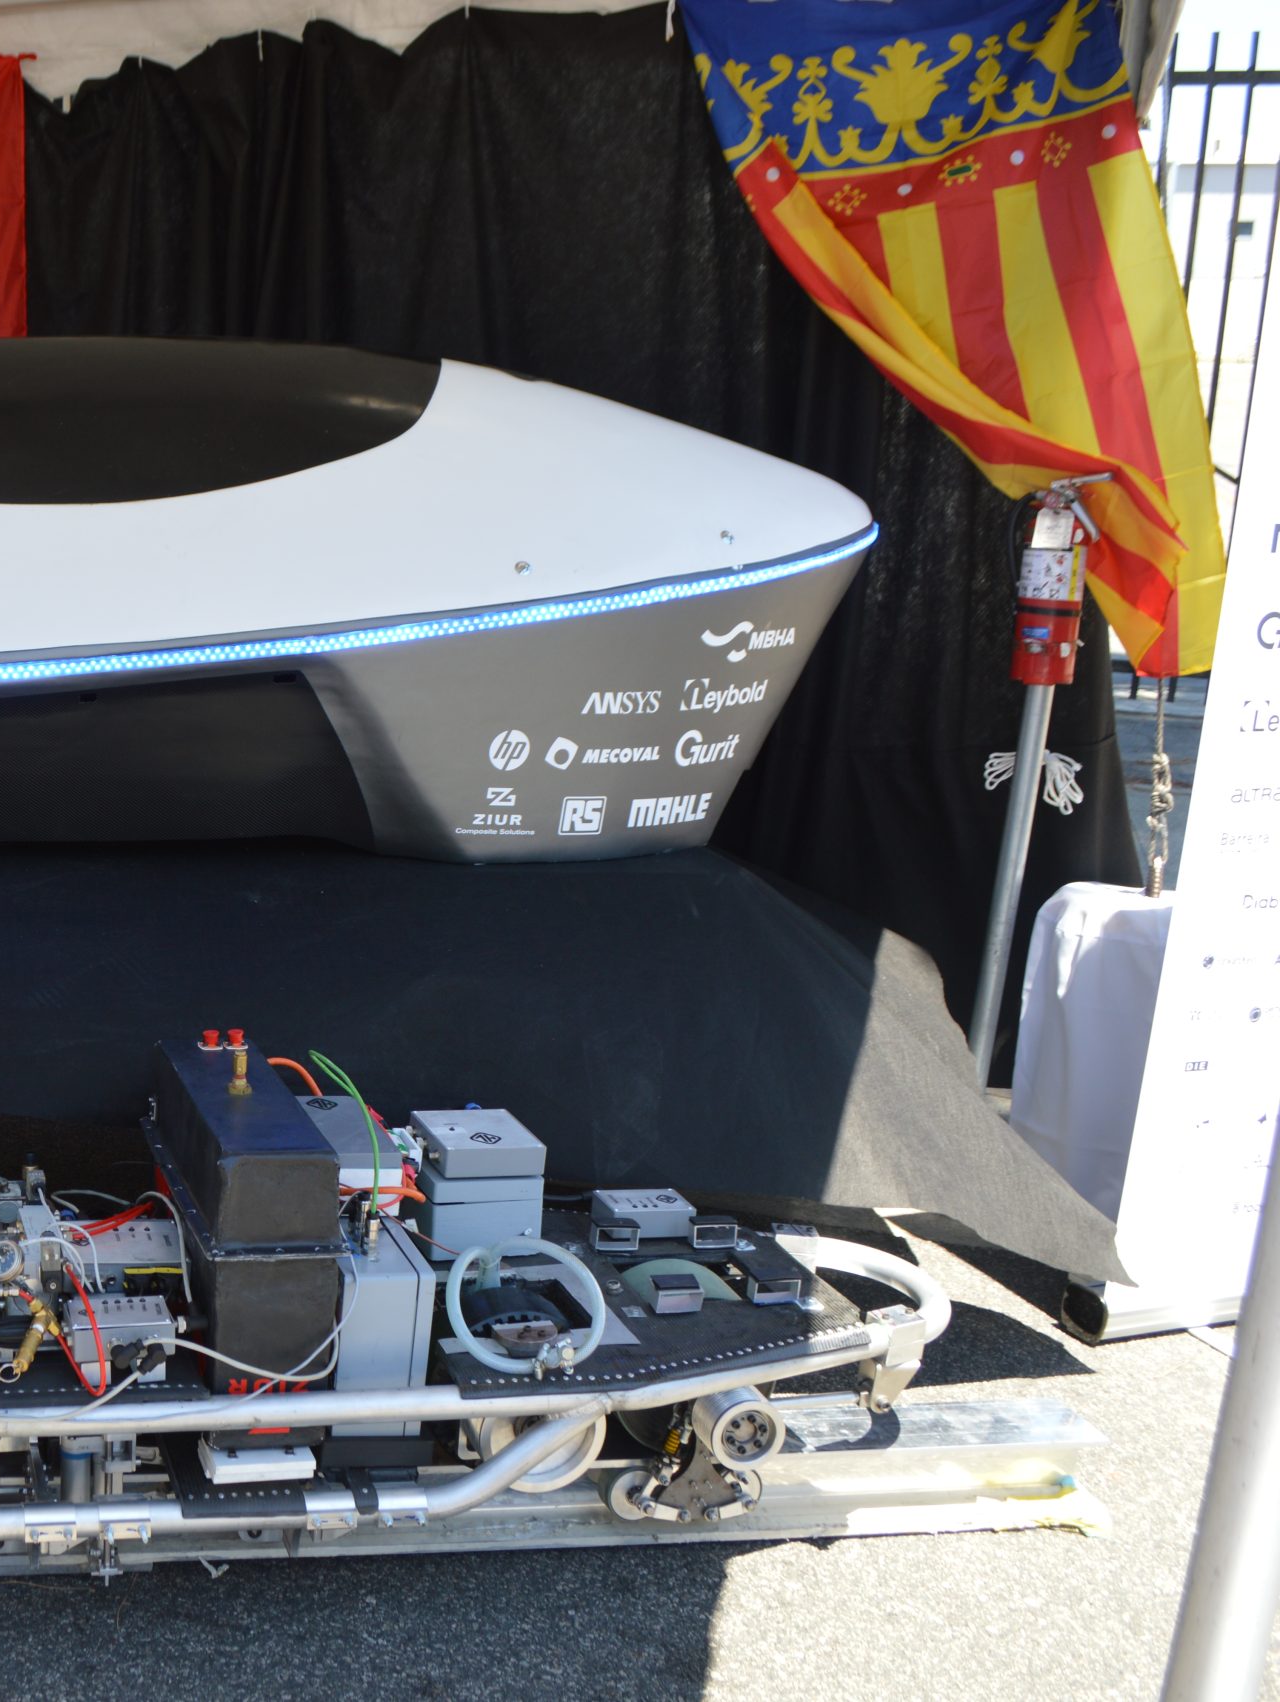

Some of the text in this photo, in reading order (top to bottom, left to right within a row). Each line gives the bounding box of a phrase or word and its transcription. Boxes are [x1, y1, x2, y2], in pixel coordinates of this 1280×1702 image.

[748, 627, 795, 651] MBHA
[581, 690, 662, 715] ANSYS
[691, 679, 768, 714] Leybold
[489, 730, 530, 771] hp
[582, 746, 660, 764] MECOVAL
[675, 729, 740, 767] Gurit
[472, 813, 522, 825] ZIUR
[562, 799, 605, 832] RS
[628, 792, 712, 828] MAHLE
[455, 827, 535, 836] Composite Solutions
